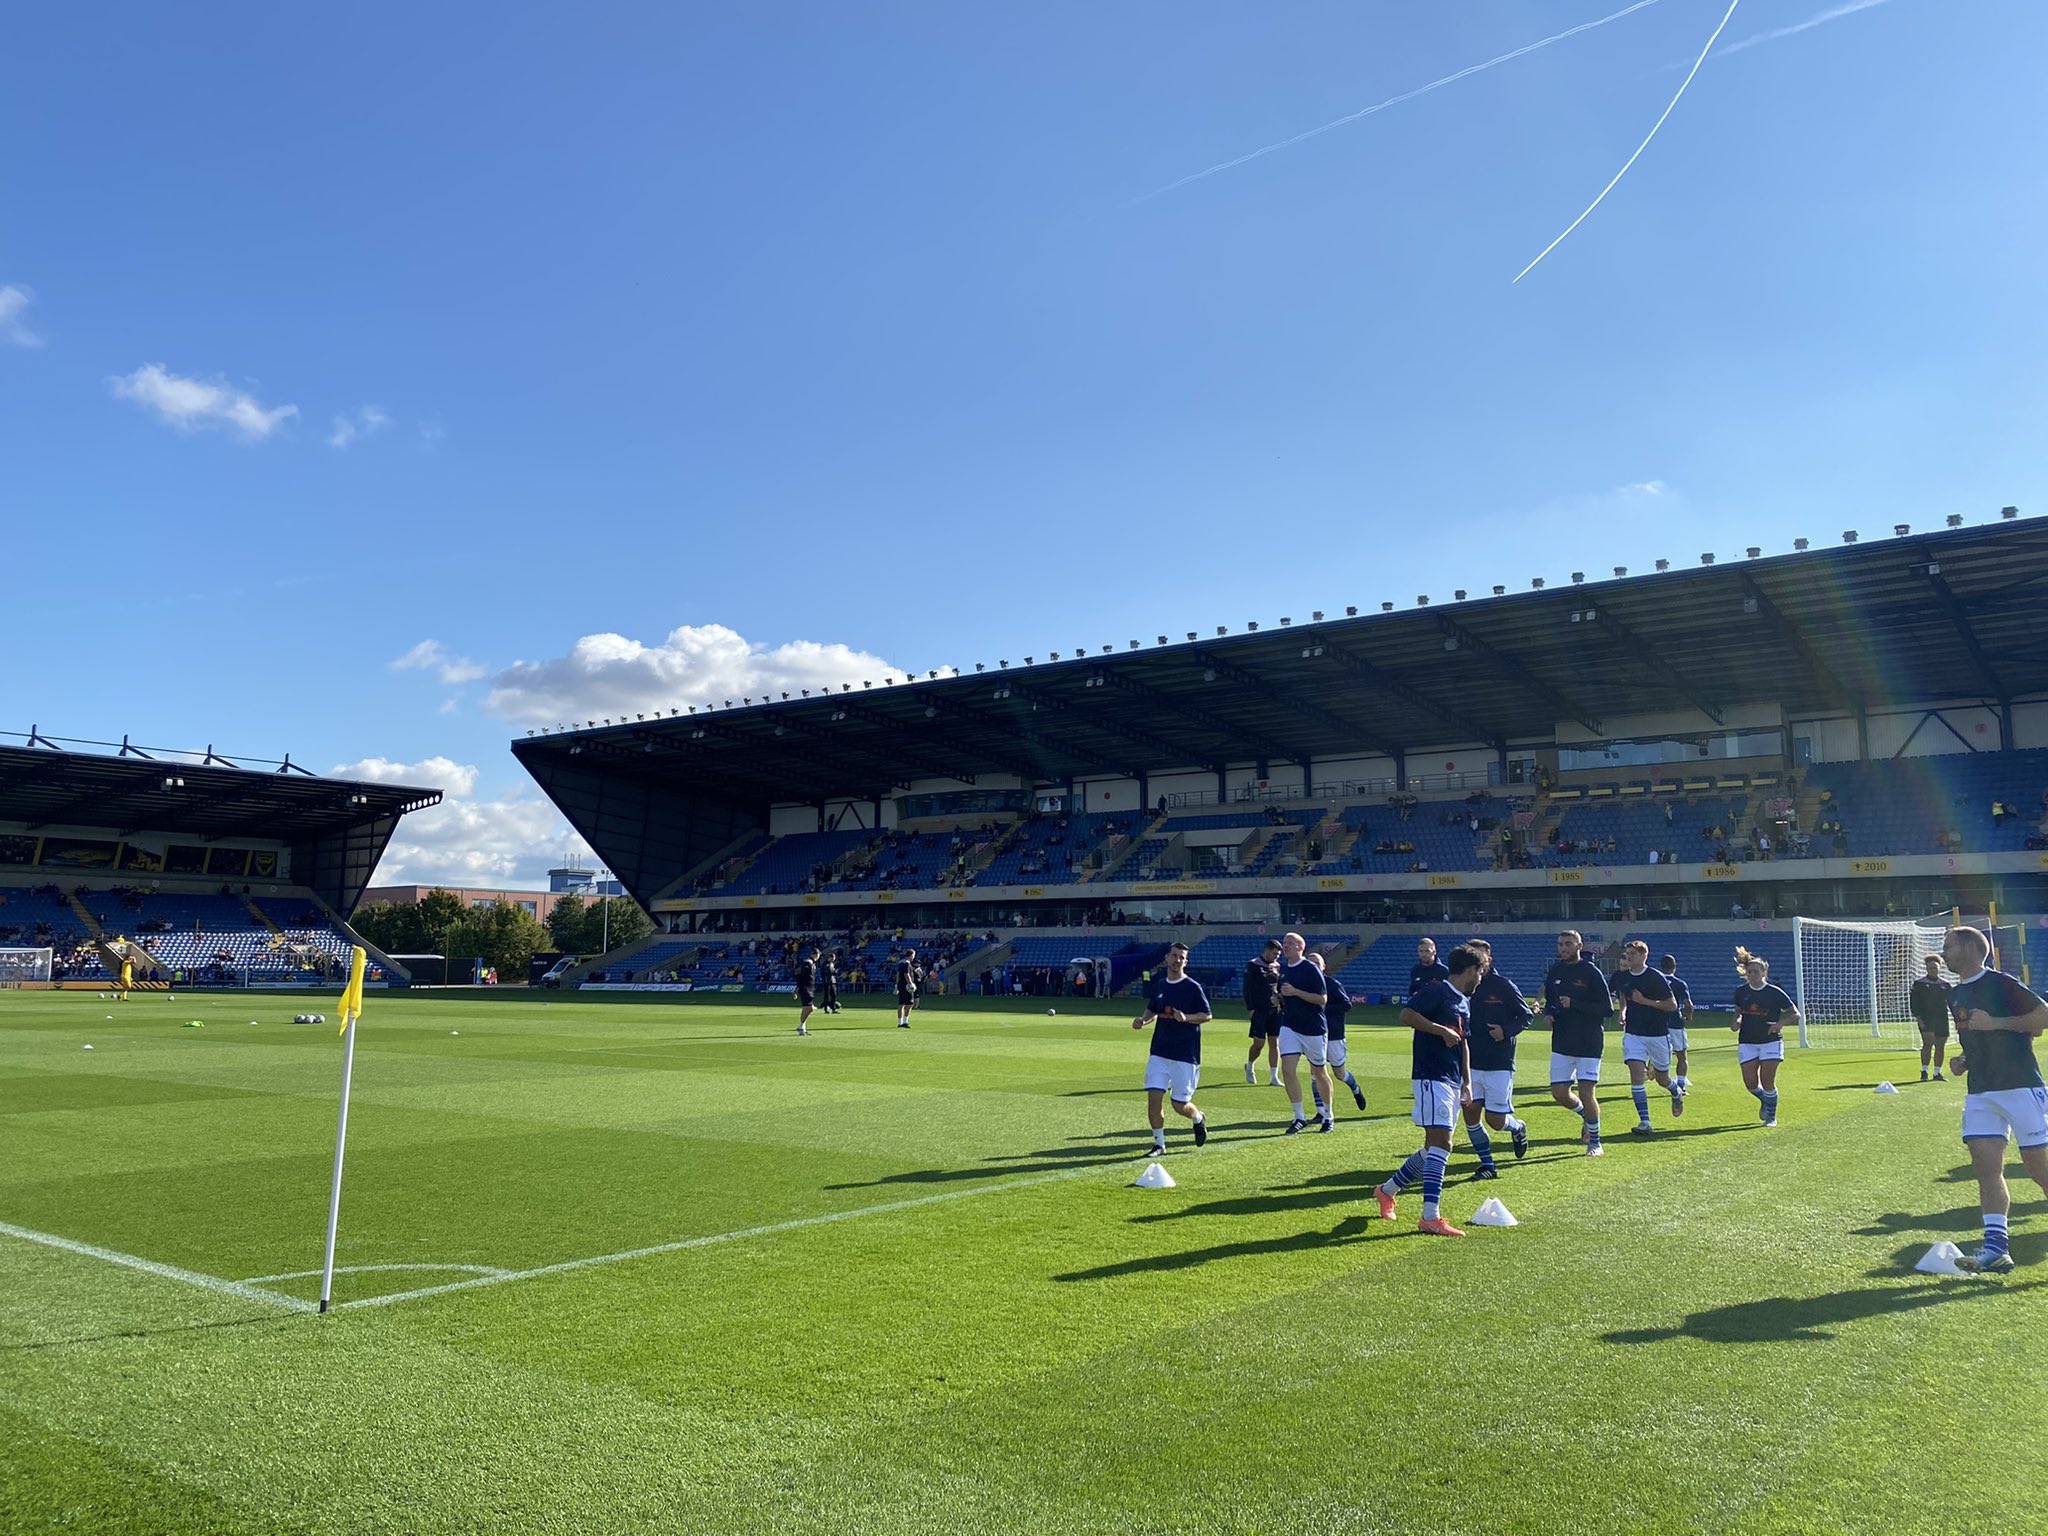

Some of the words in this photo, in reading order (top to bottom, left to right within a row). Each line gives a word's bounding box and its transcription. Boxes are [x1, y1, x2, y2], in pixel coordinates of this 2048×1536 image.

[1864, 862, 1887, 871] 2010
[1715, 867, 1736, 876] 1986
[1561, 872, 1580, 881] 1985
